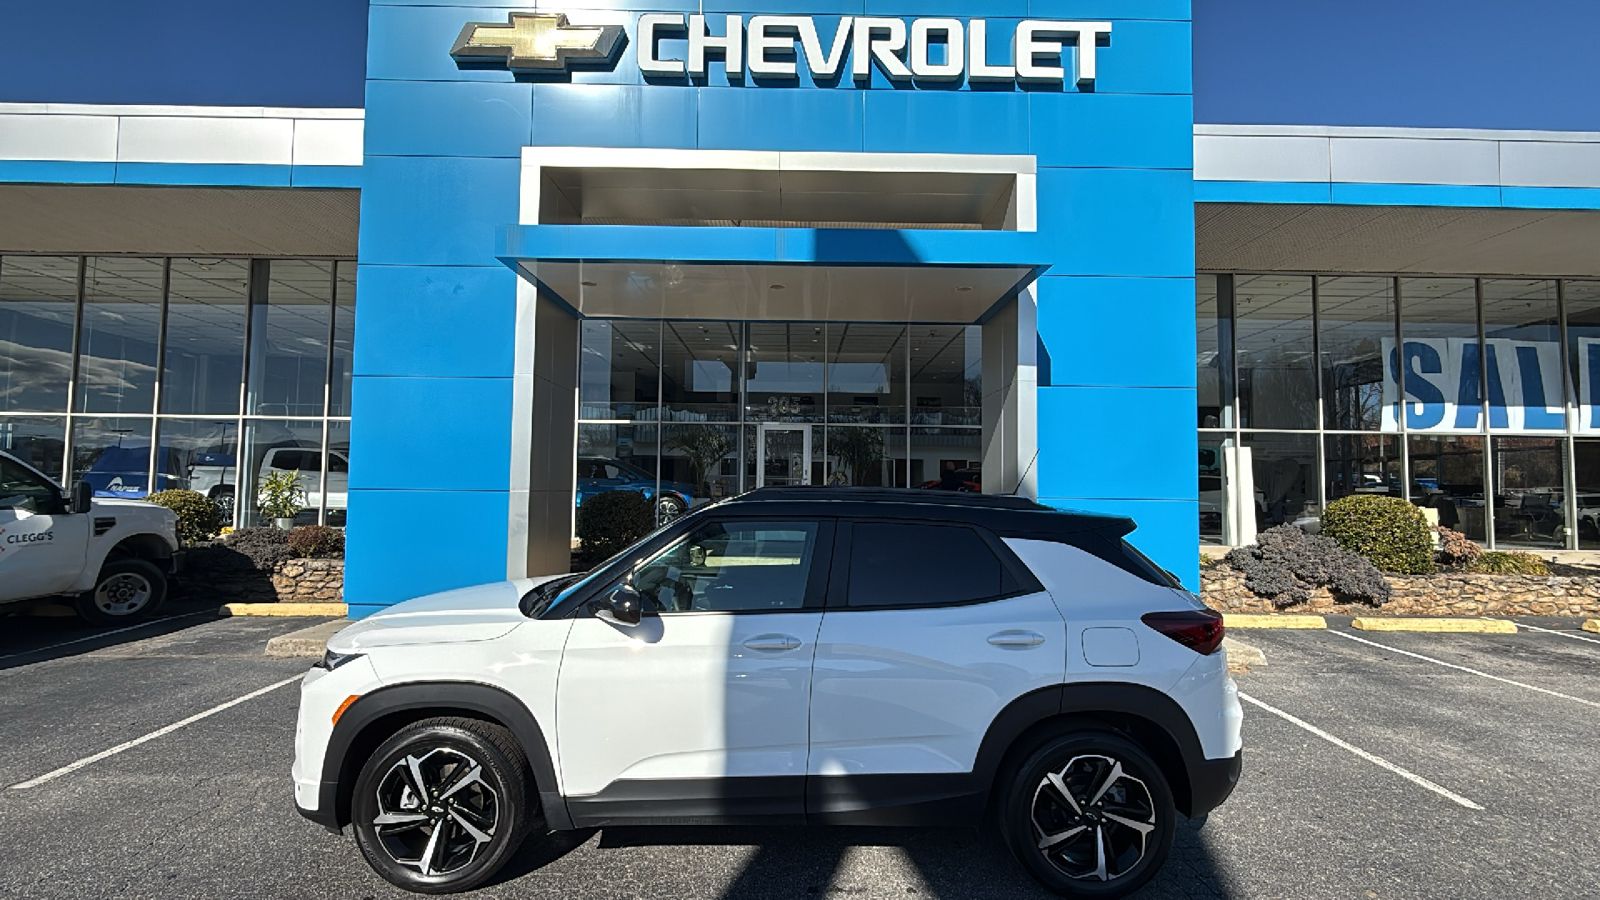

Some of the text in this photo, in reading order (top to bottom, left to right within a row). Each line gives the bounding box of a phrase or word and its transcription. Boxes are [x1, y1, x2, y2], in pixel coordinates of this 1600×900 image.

[637, 13, 1112, 91] CHEVROLET
[1390, 341, 1600, 429] SAL
[6, 531, 54, 544] CLEGG'S
